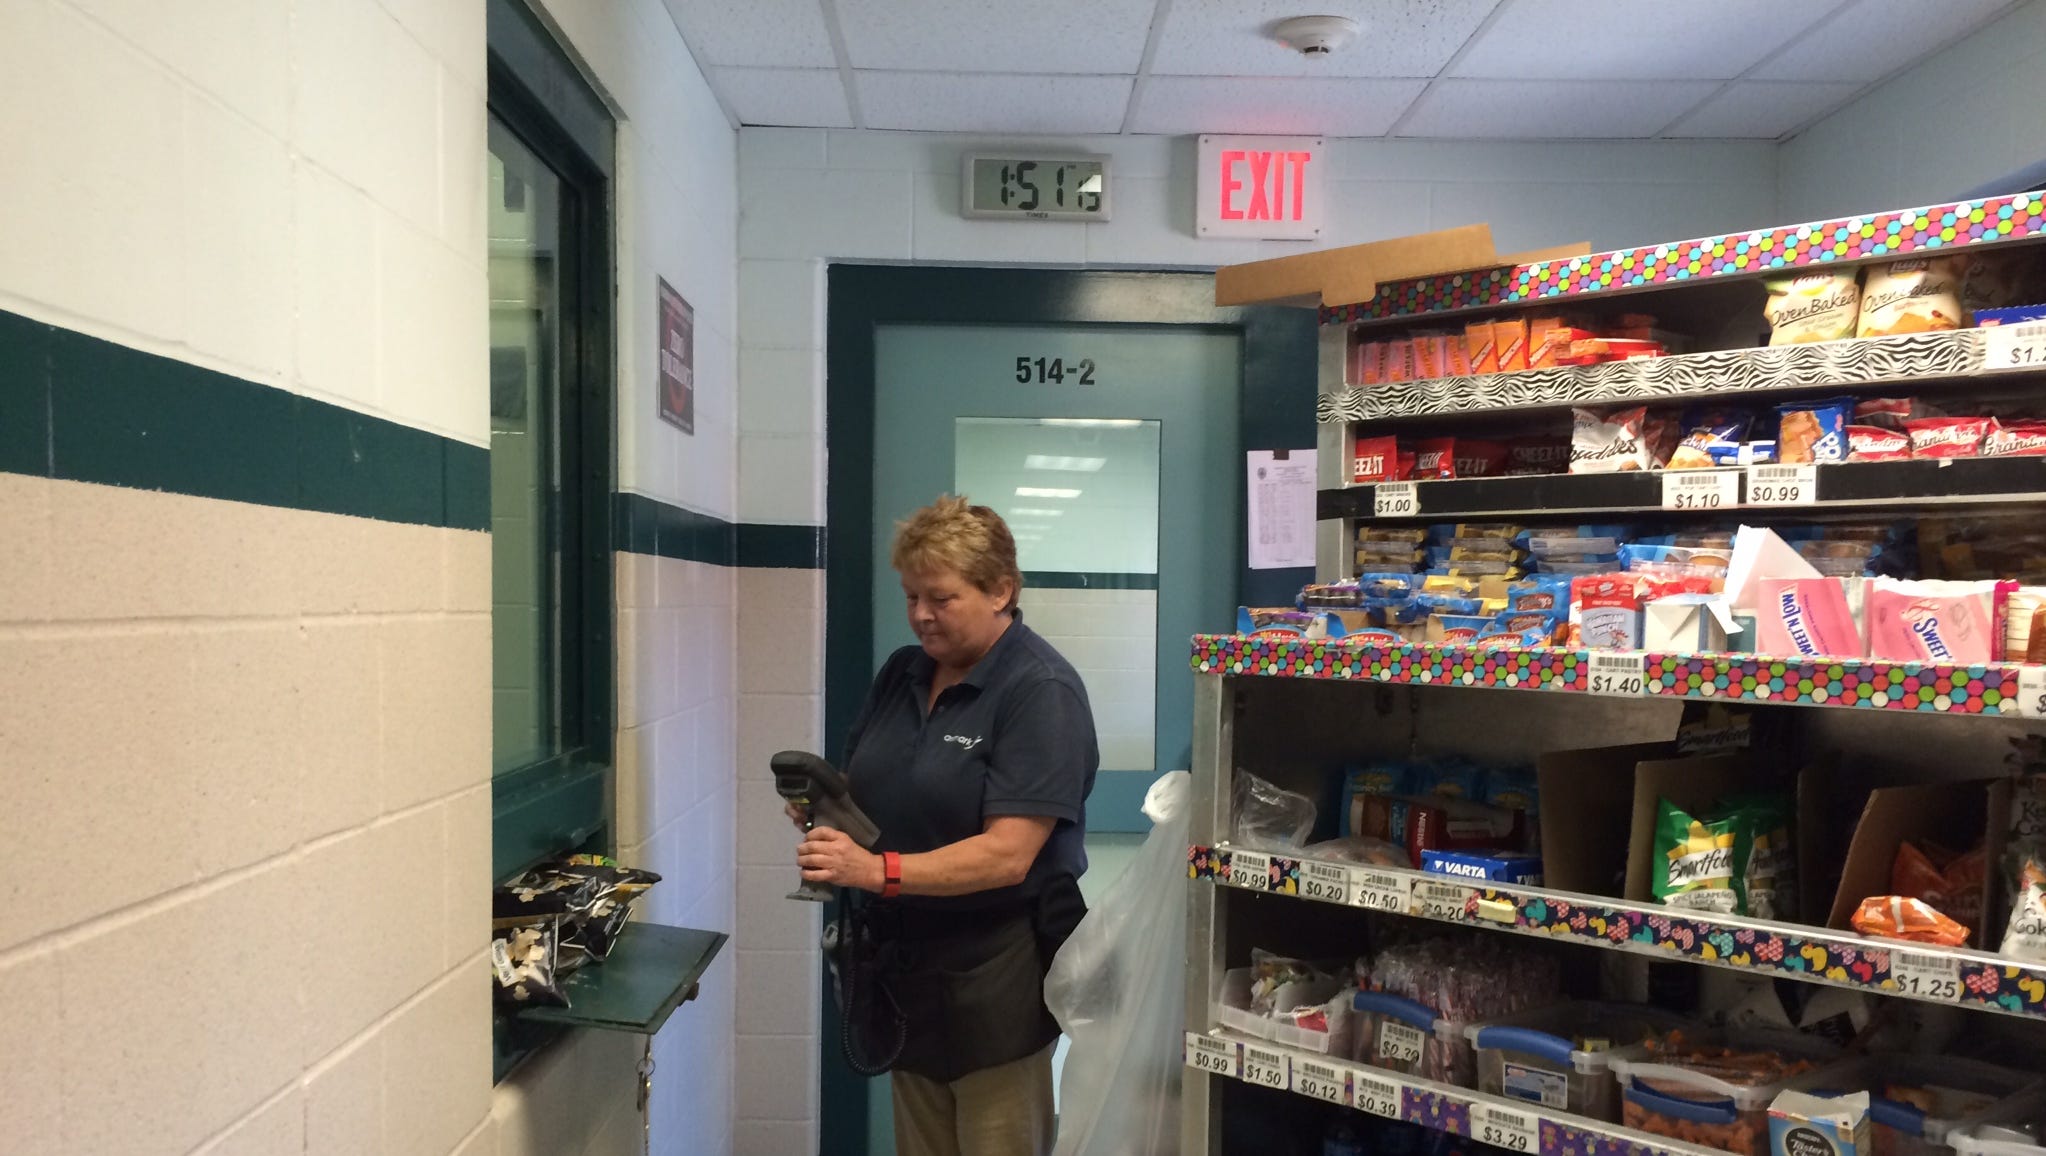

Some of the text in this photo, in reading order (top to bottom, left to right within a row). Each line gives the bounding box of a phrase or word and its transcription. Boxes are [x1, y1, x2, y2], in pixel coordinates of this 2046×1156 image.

[1001, 161, 1064, 210] 1:51
[1219, 150, 1311, 221] EXIT
[1770, 307, 1810, 327] Oven
[1810, 286, 1858, 313] Baked
[1016, 356, 1096, 386] 514-2
[1354, 455, 1385, 476] EEZ-IT
[1674, 493, 1721, 509] $1.10
[1751, 486, 1800, 502] $0.99
[1375, 499, 1411, 513] $1.00
[1591, 675, 1641, 693] $1.40
[1232, 869, 1267, 888] $0.99
[1444, 861, 1487, 879] VARTA
[1305, 880, 1343, 901] $0.20
[1358, 890, 1399, 910] $0.50
[1896, 973, 1957, 999] $1.25
[1194, 1052, 1229, 1073] $0.99
[1246, 1064, 1282, 1086] $1.50
[1300, 1078, 1337, 1101] $0.12
[1356, 1094, 1397, 1117] $0.39
[1483, 1126, 1528, 1151] $3.29
